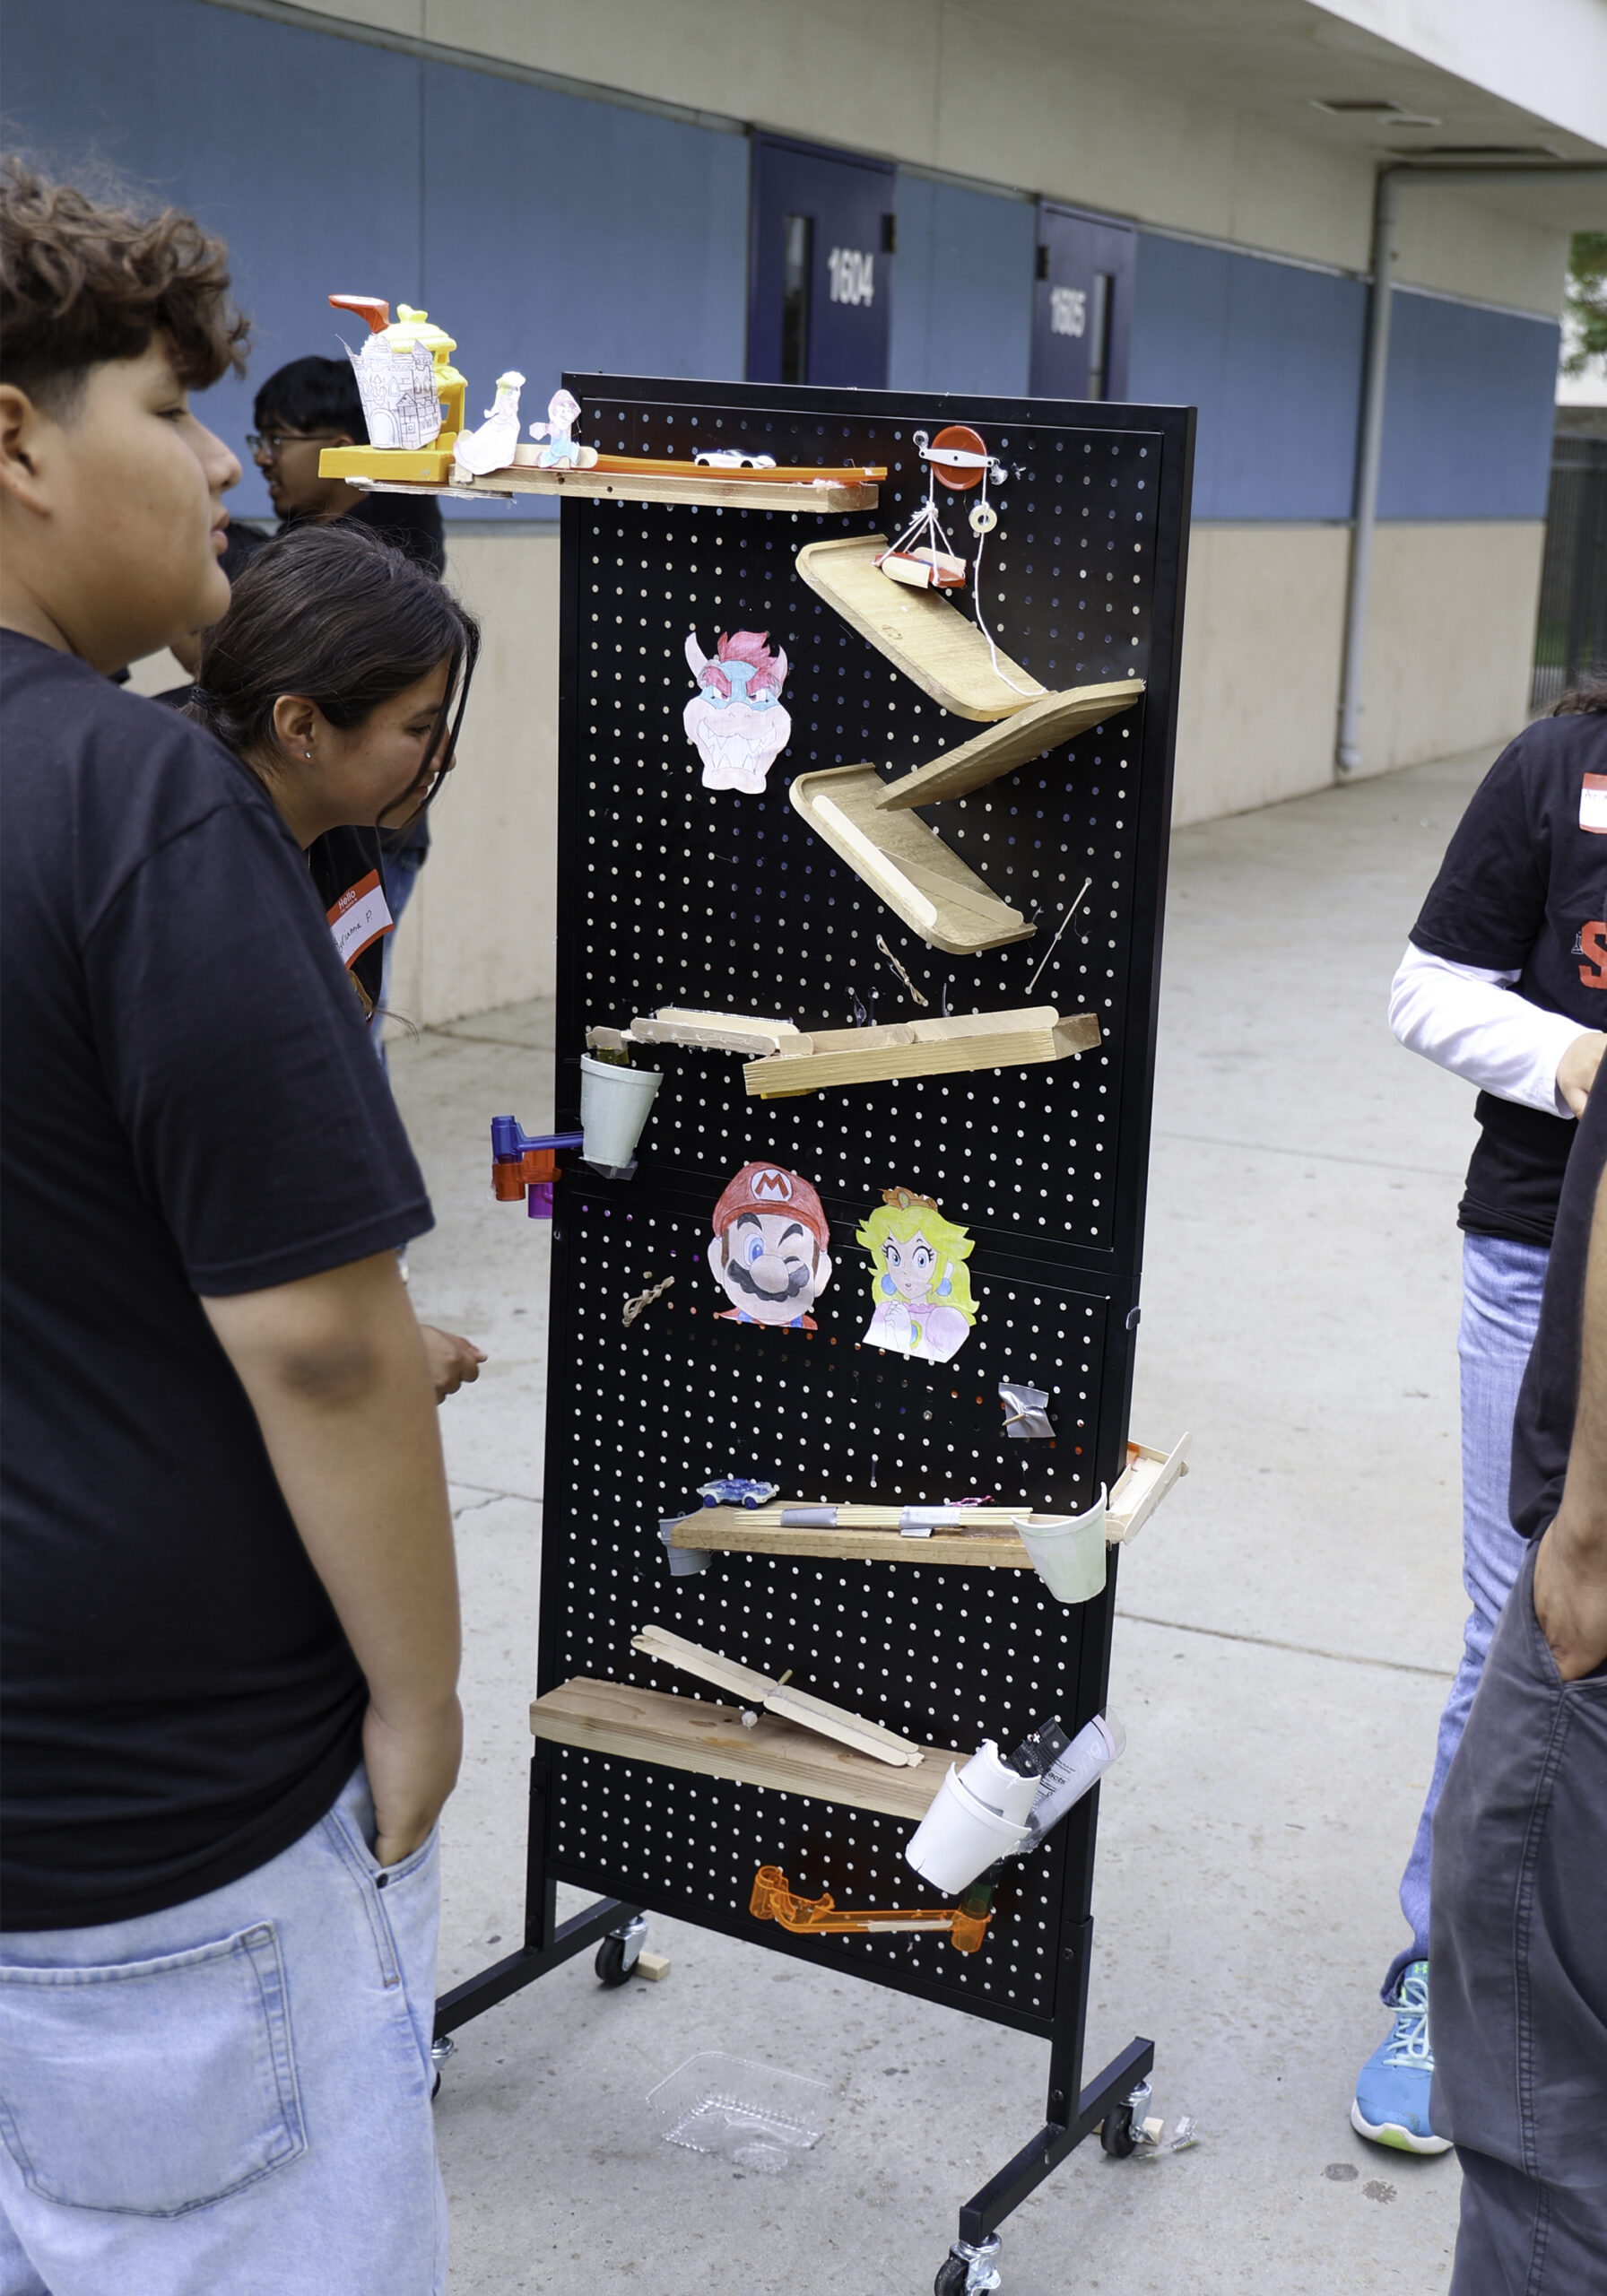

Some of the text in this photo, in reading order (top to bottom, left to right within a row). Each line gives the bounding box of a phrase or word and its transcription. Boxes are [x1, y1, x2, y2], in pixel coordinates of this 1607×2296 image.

[829, 246, 875, 307] 1604
[338, 890, 356, 909] Hello
[755, 1172, 789, 1197] M
